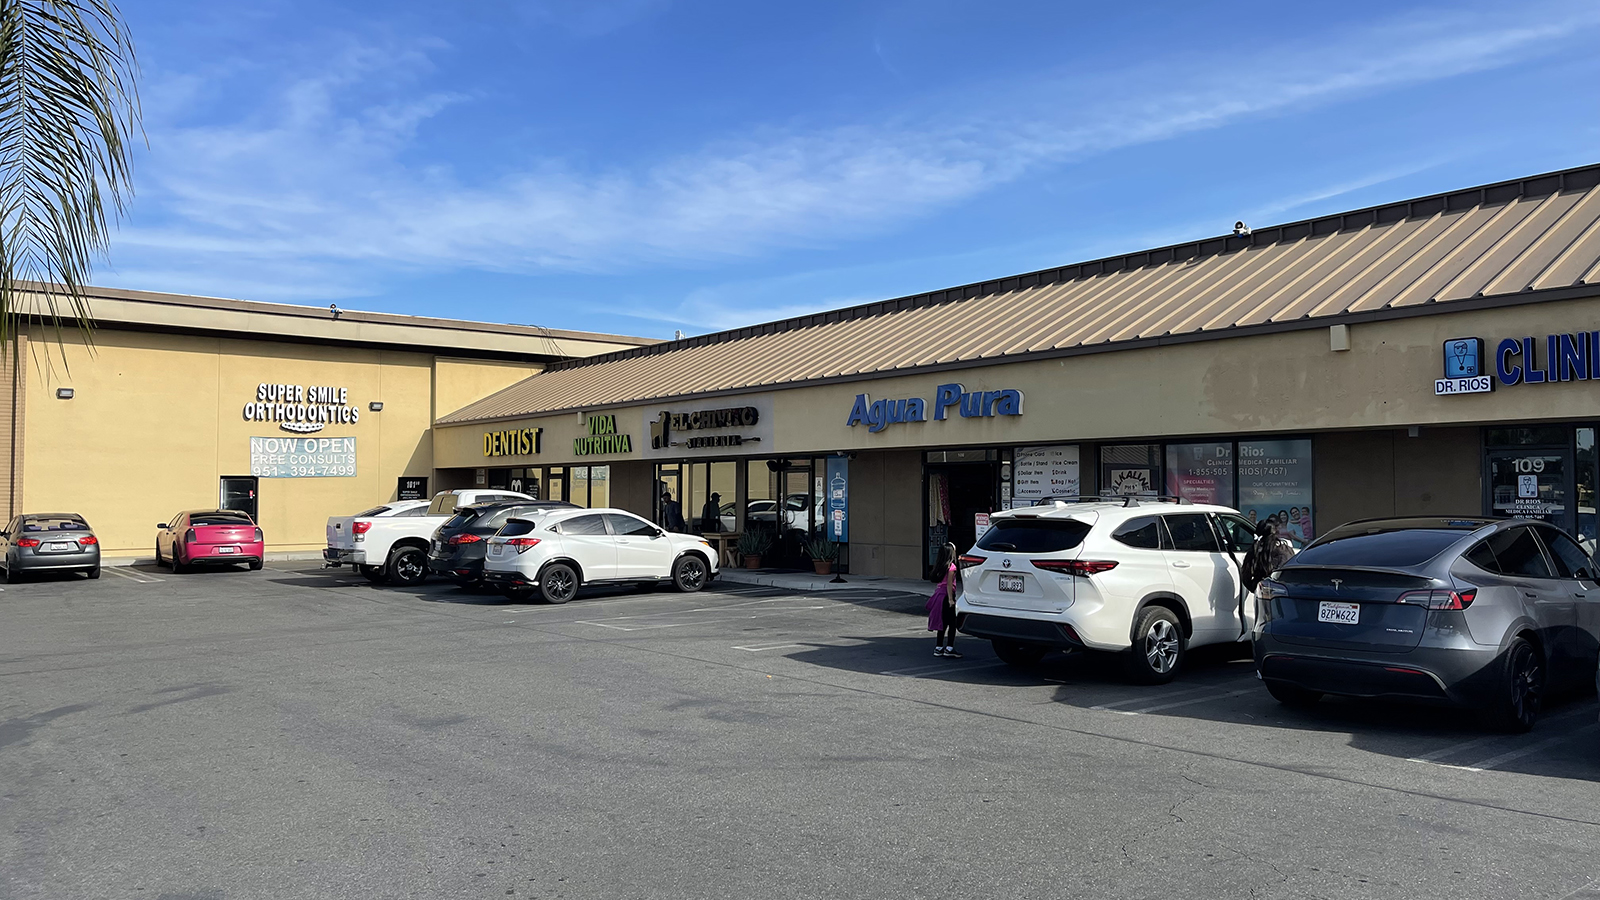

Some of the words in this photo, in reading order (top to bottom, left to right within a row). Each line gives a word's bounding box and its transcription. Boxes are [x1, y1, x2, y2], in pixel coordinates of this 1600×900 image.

[257, 383, 303, 402] SUPER
[308, 385, 348, 404] SMILE
[1436, 380, 1457, 393] DR.
[1459, 378, 1489, 392] RIOS
[244, 402, 360, 424] ORTHODONTICS
[846, 393, 928, 433] Agua
[933, 383, 1025, 421] Pura
[587, 415, 616, 435] VIDA
[670, 413, 688, 431] EL
[251, 438, 298, 453] NOW
[304, 438, 355, 453] OPEN
[483, 427, 542, 457] DENTIST
[573, 434, 631, 456] NUTRITIVA
[1240, 445, 1265, 457] Rios
[252, 455, 285, 465] FREE
[290, 454, 356, 465] CONSULTS
[1512, 459, 1545, 473] 109
[253, 466, 286, 477] 951-
[291, 465, 354, 476] 394-7499
[1188, 468, 1228, 476] 1-855-505
[1239, 467, 1288, 477] RIOS(7467)
[1112, 470, 1150, 494] ALKALINE
[1321, 609, 1356, 621] 8ZPW622
